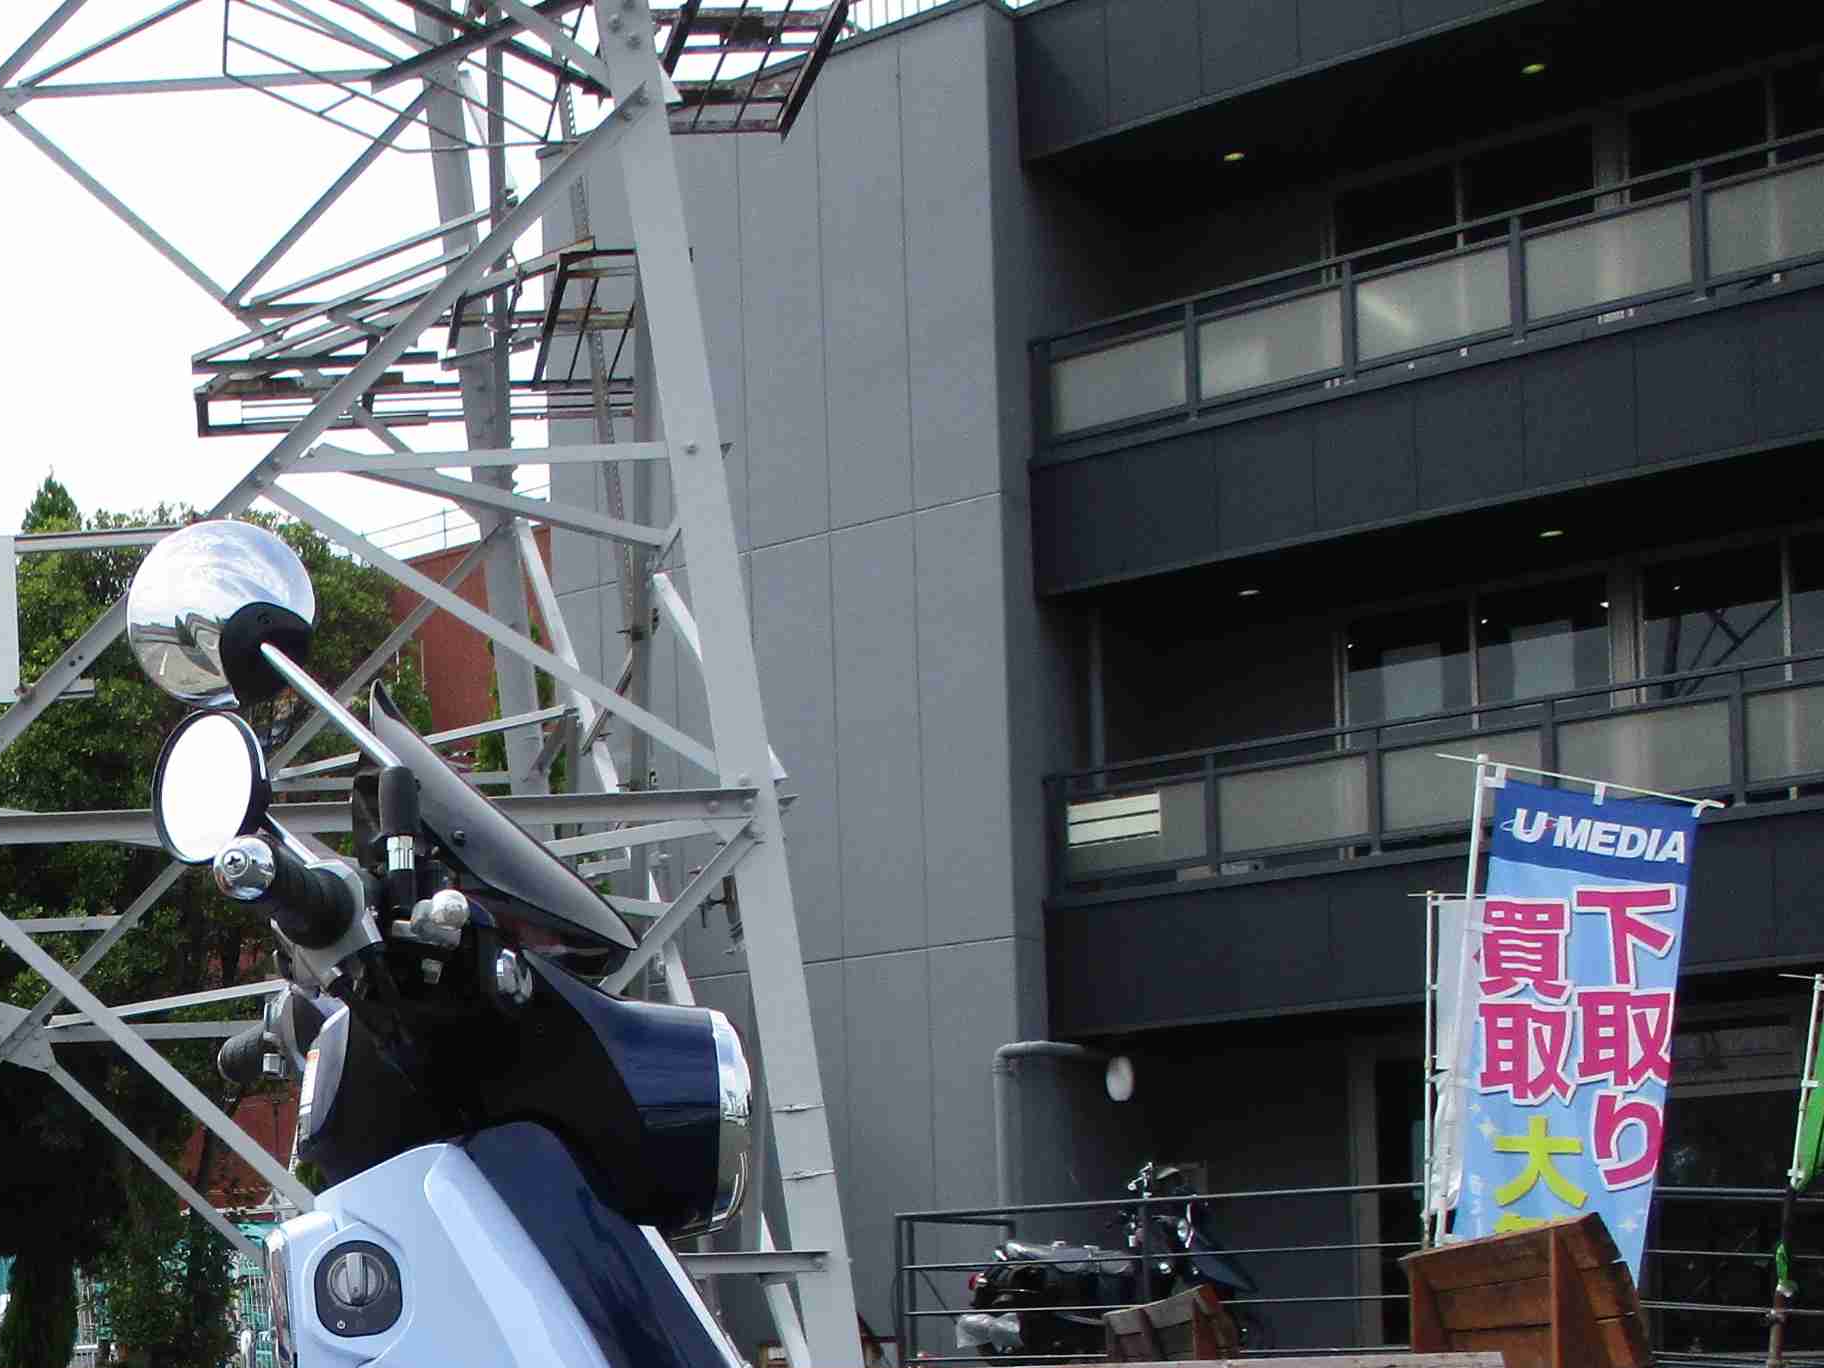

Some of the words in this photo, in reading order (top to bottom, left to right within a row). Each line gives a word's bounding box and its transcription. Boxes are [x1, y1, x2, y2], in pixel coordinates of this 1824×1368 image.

[1553, 816, 1686, 863] MEDIA
[1575, 883, 1676, 1191] 下取り
